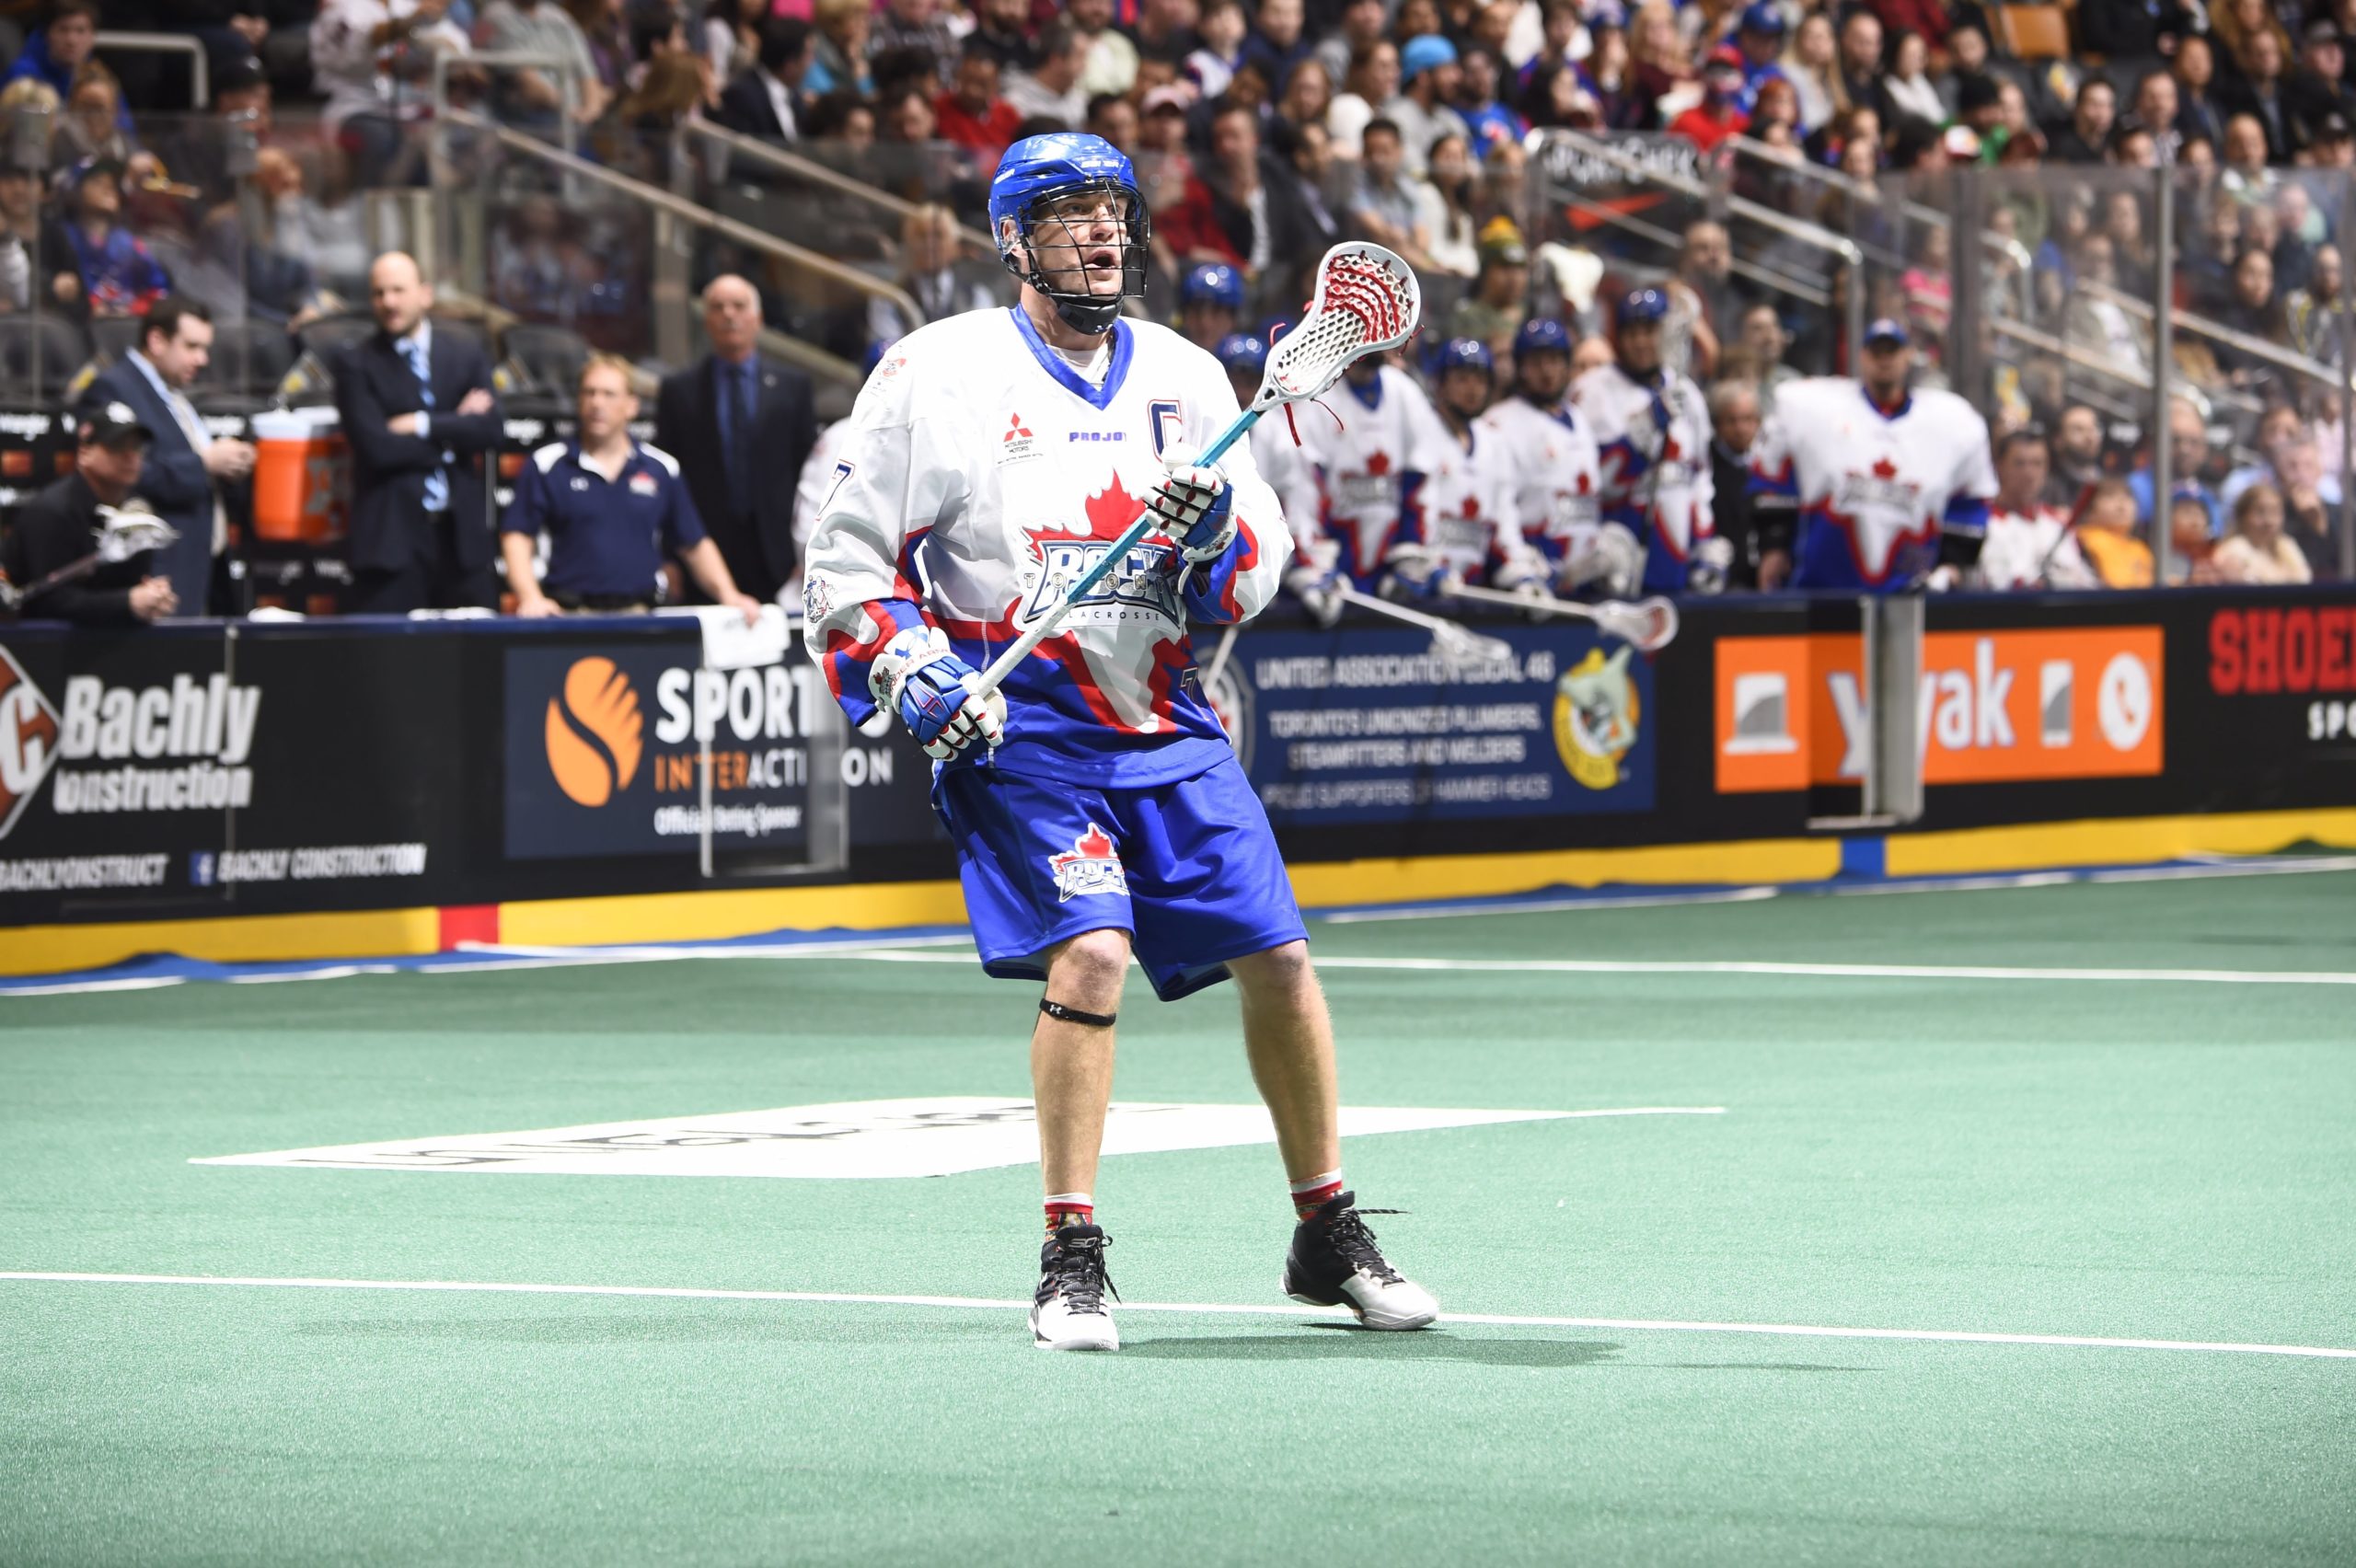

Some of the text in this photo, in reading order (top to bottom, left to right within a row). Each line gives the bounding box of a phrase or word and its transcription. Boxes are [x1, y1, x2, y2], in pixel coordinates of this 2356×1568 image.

[1069, 432, 1126, 442] PROJO
[1023, 572, 1180, 596] TOONTO
[1068, 610, 1160, 622] LACROSSE
[2209, 607, 2356, 697] SHOE
[1255, 658, 1331, 688] UNITED
[59, 674, 260, 764] Bachly
[654, 746, 894, 792] INTERACTION
